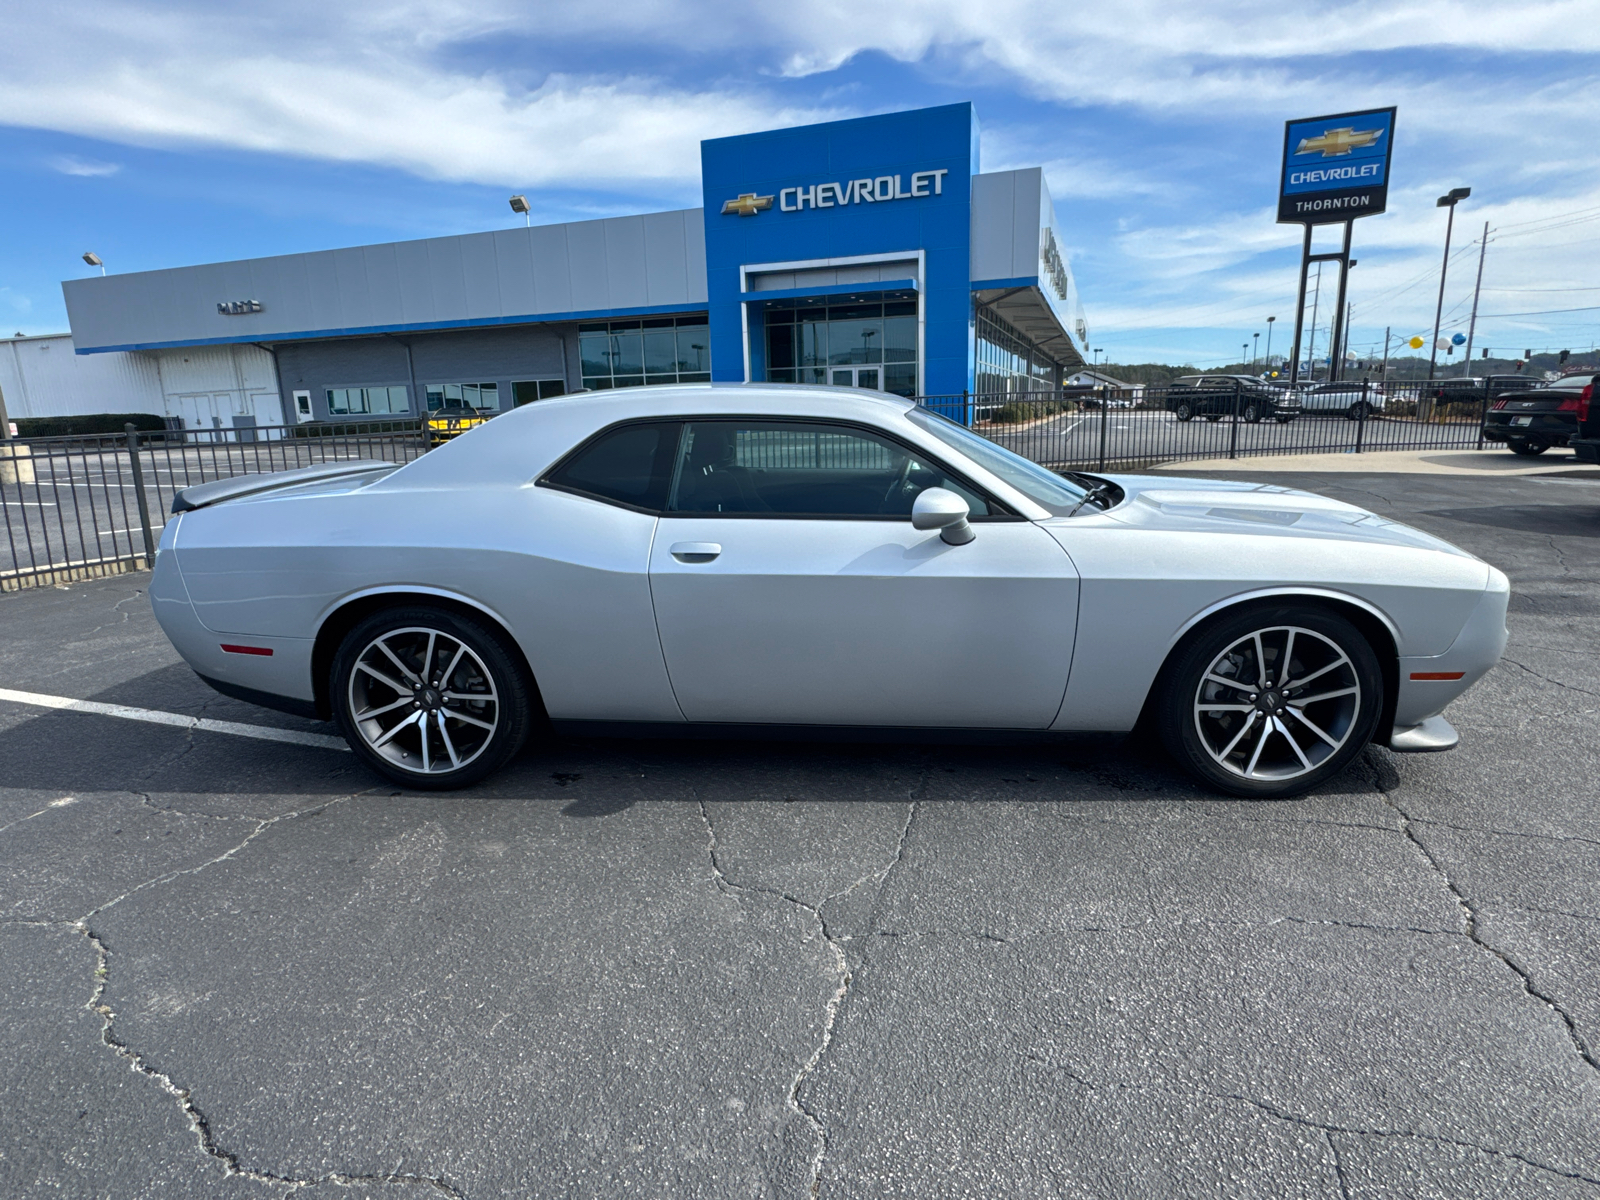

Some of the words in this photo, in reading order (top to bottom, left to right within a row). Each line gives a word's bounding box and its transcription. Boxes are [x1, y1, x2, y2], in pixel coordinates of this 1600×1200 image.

[1290, 163, 1381, 185] CHEVROLET
[779, 169, 949, 212] CHEVROLET
[1296, 195, 1370, 212] THORNTON
